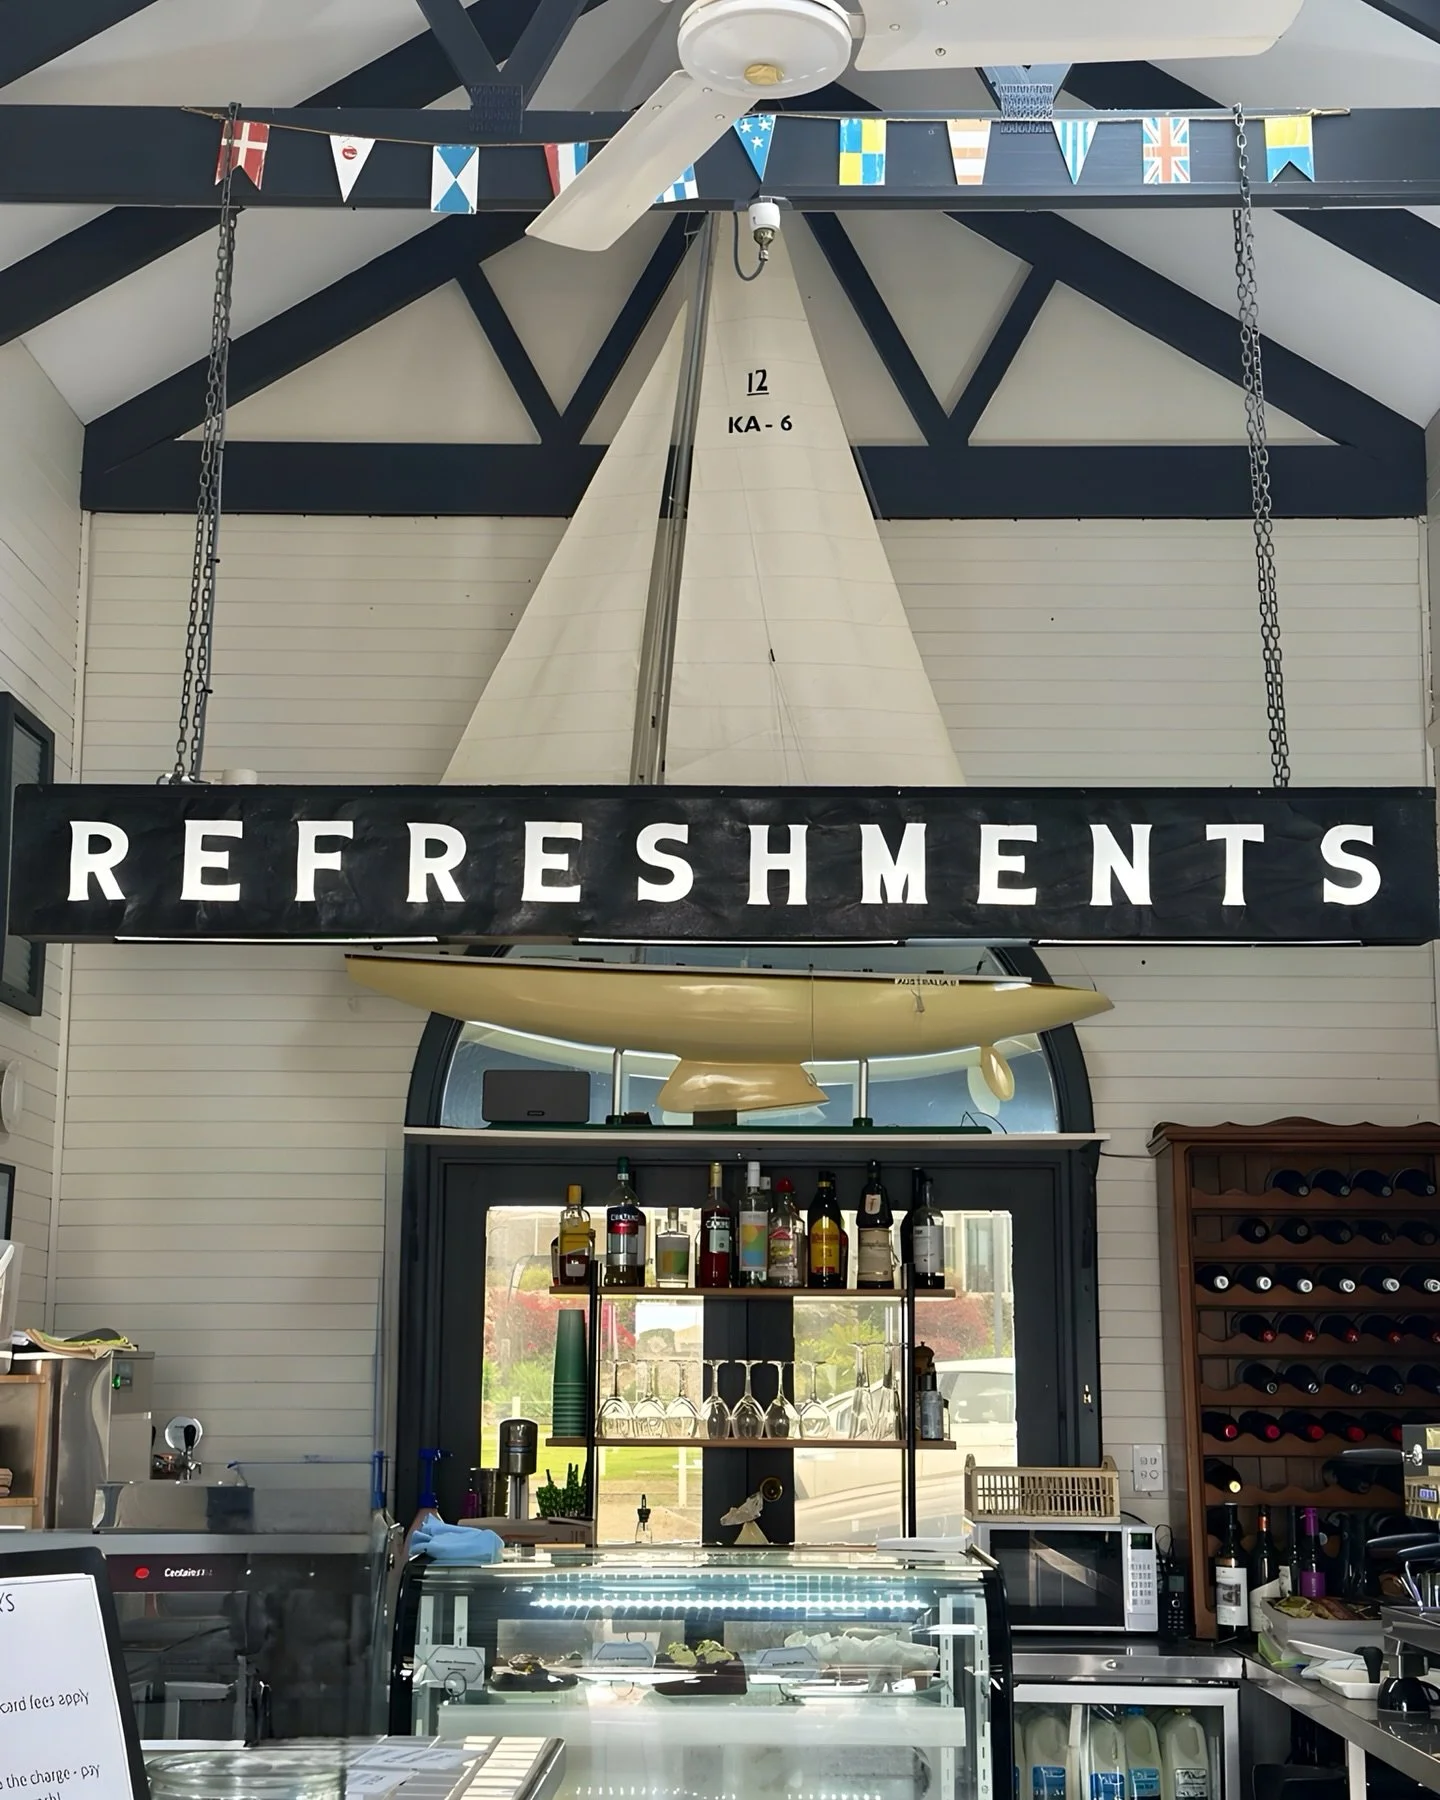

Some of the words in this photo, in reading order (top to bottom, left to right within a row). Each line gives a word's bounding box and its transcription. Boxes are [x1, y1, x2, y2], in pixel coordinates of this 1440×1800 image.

[747, 369, 769, 396] 12
[67, 819, 1382, 907] REFRESHMENTS
[6, 1773, 28, 1789] the
[30, 1769, 70, 1784] charge
